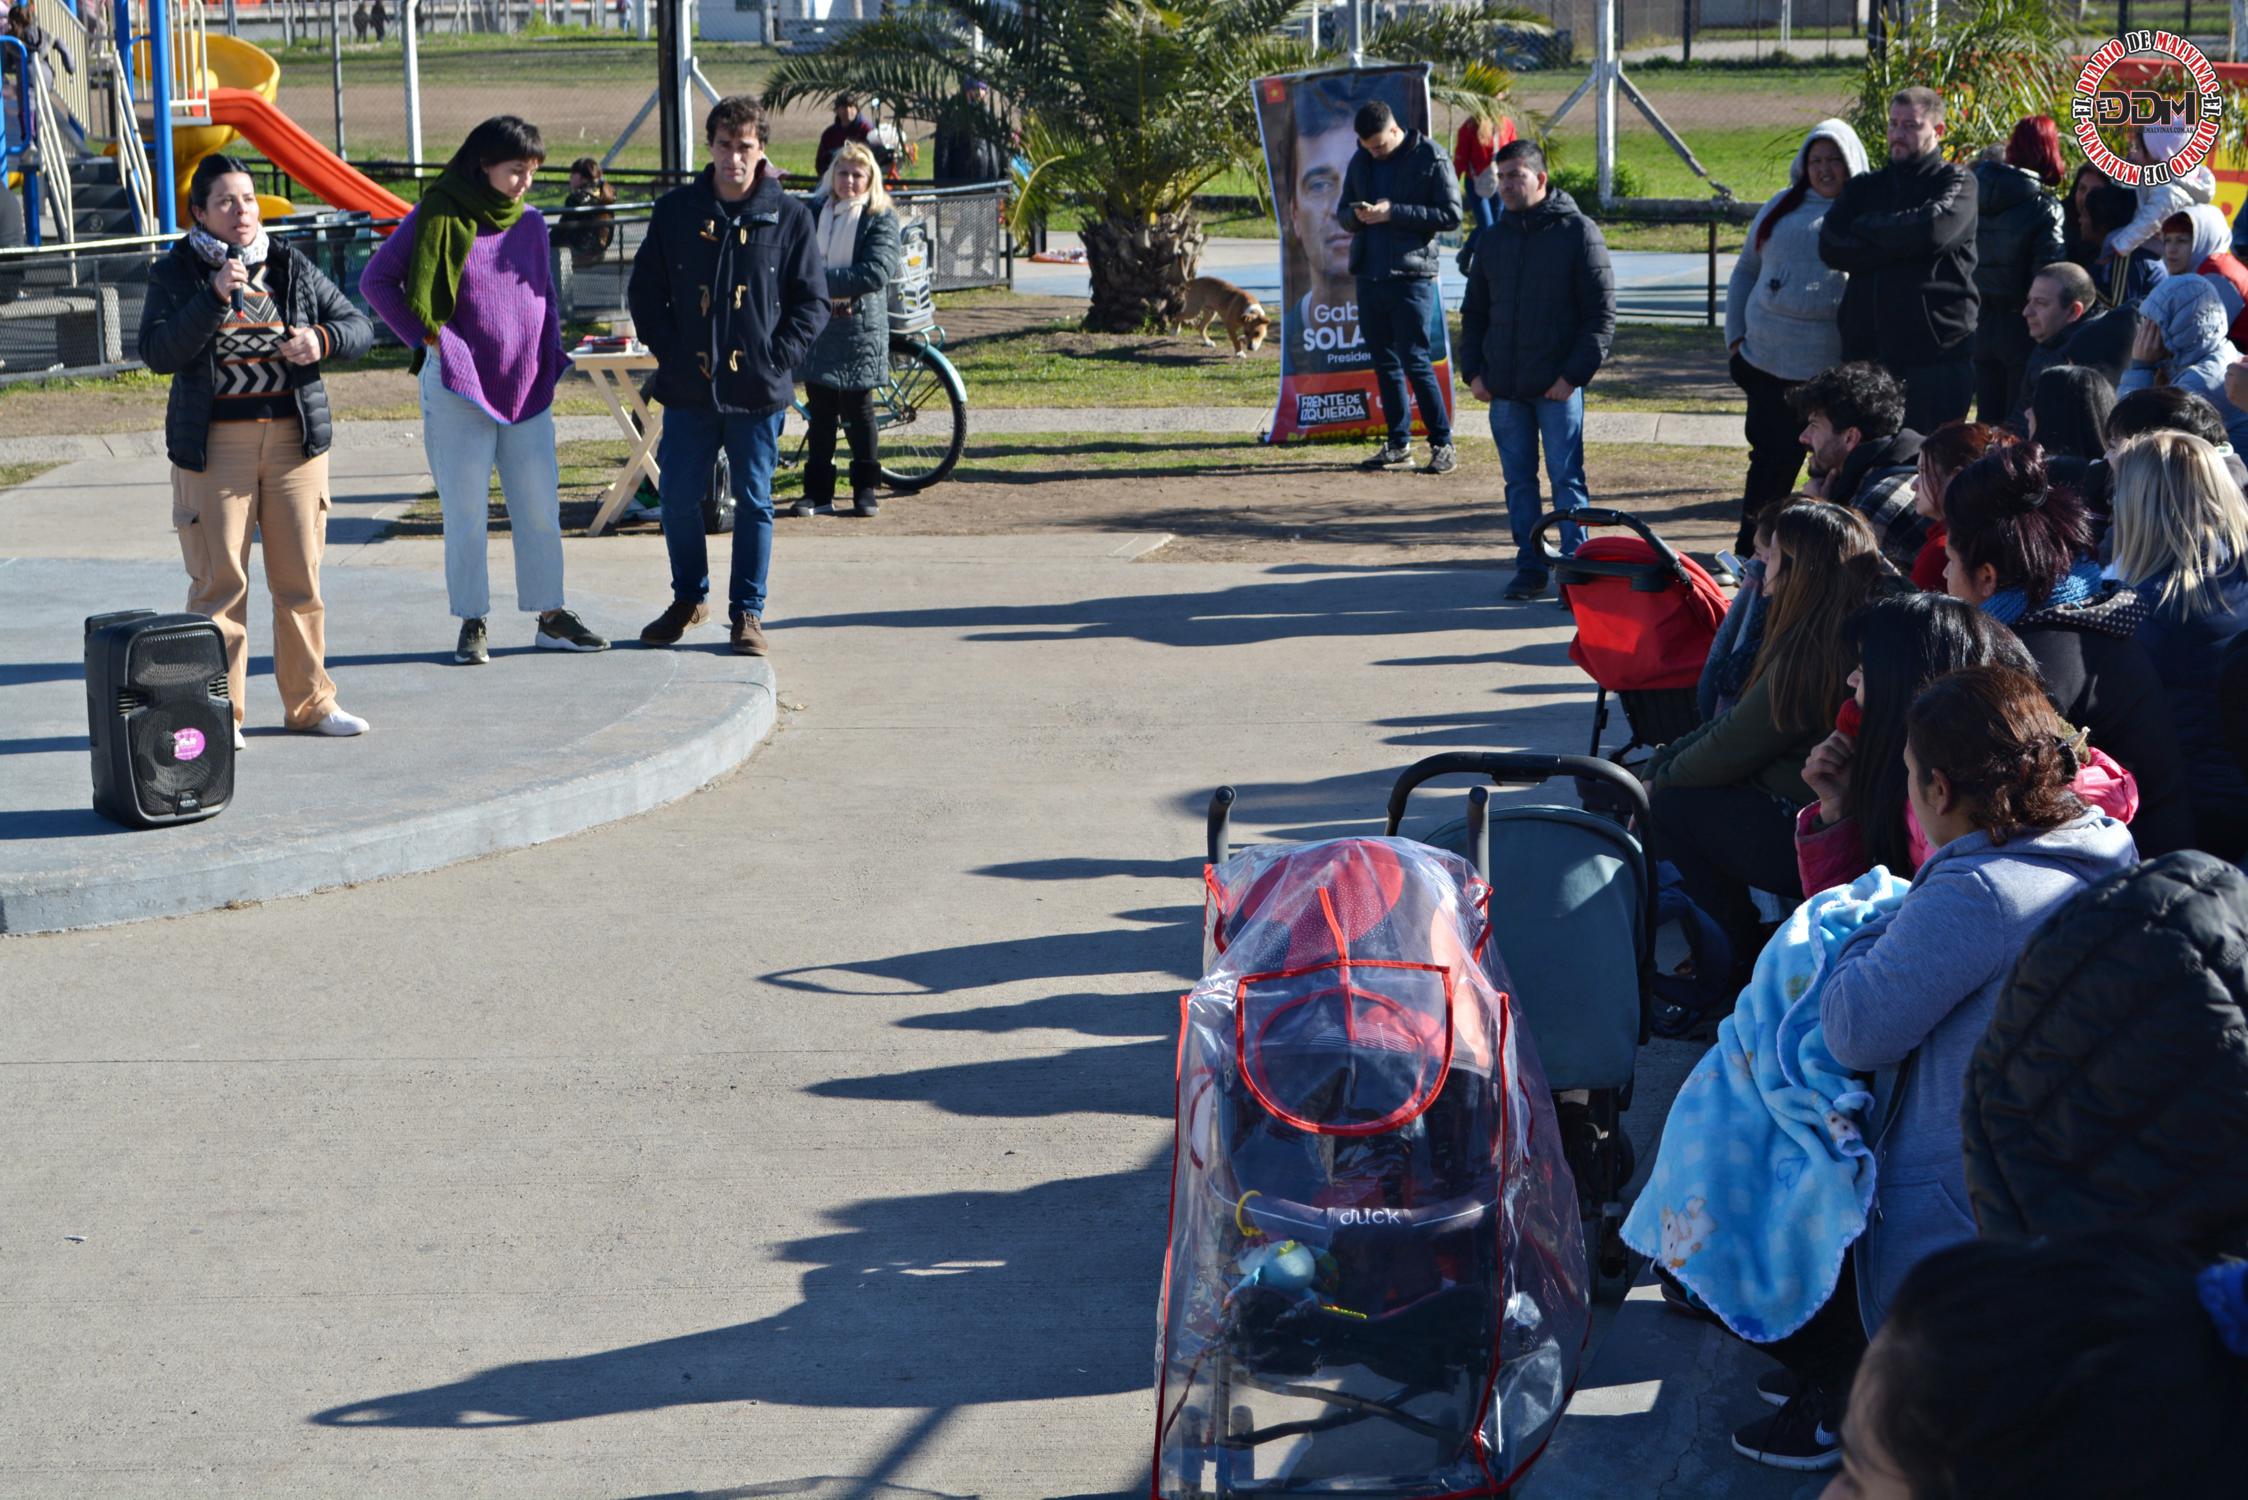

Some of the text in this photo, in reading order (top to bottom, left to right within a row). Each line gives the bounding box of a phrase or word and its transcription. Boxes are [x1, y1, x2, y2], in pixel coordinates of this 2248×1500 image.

[1301, 393, 1360, 408] FRENTE DE
[1300, 405, 1366, 421] IZQUIERDA
[1340, 1208, 1401, 1225] duck
